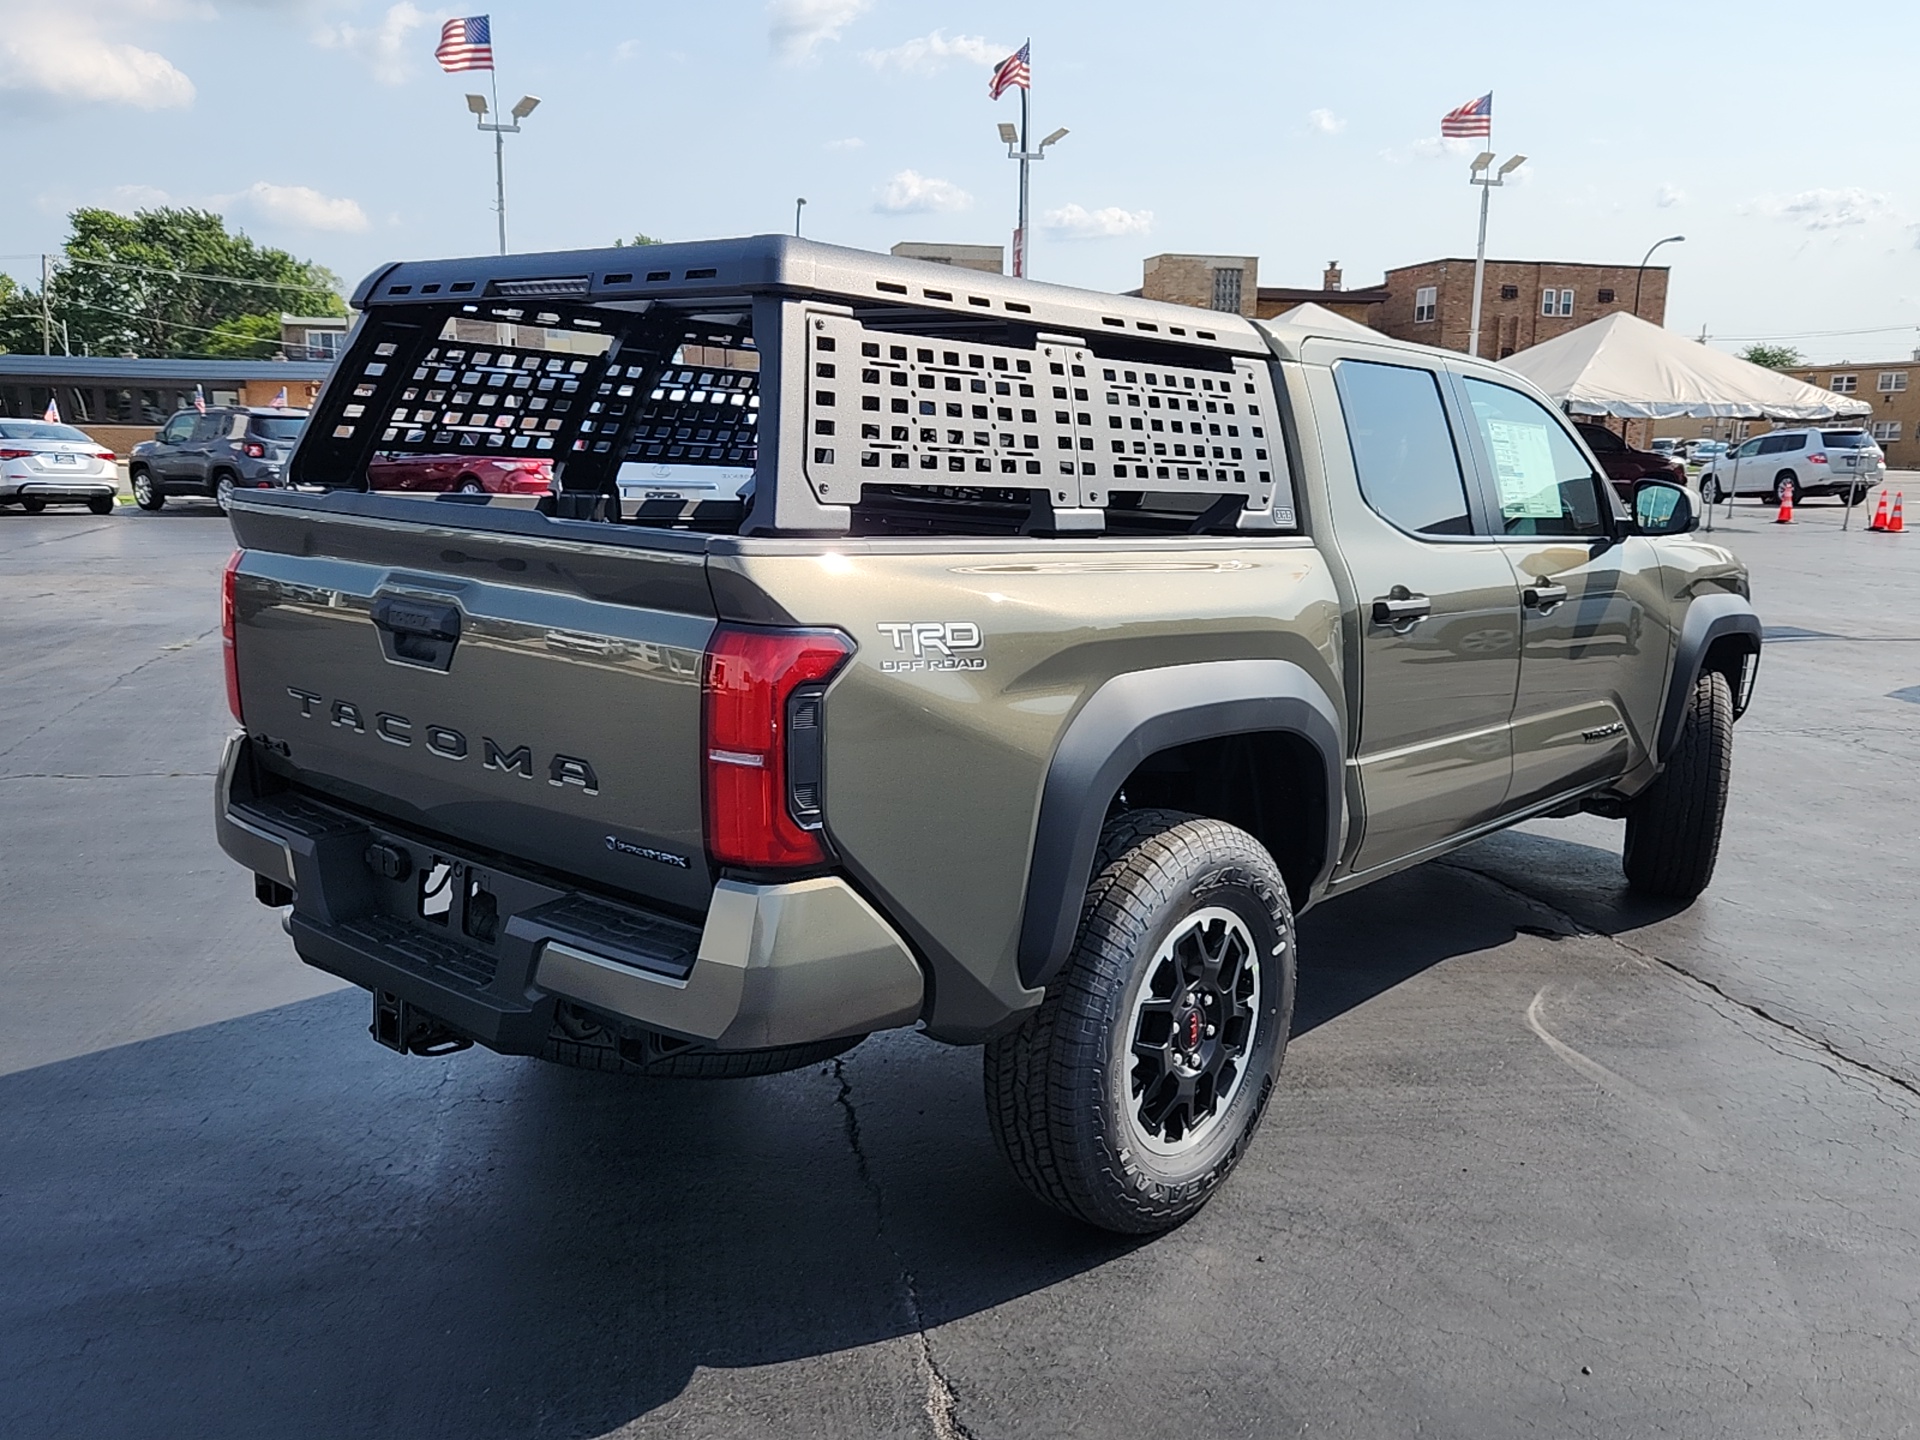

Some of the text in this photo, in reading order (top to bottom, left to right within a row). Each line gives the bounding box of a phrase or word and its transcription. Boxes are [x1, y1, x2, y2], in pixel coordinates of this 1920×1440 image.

[876, 621, 984, 658] TRD
[880, 658, 988, 673] OFF ROAD
[286, 686, 599, 796] TACOMA
